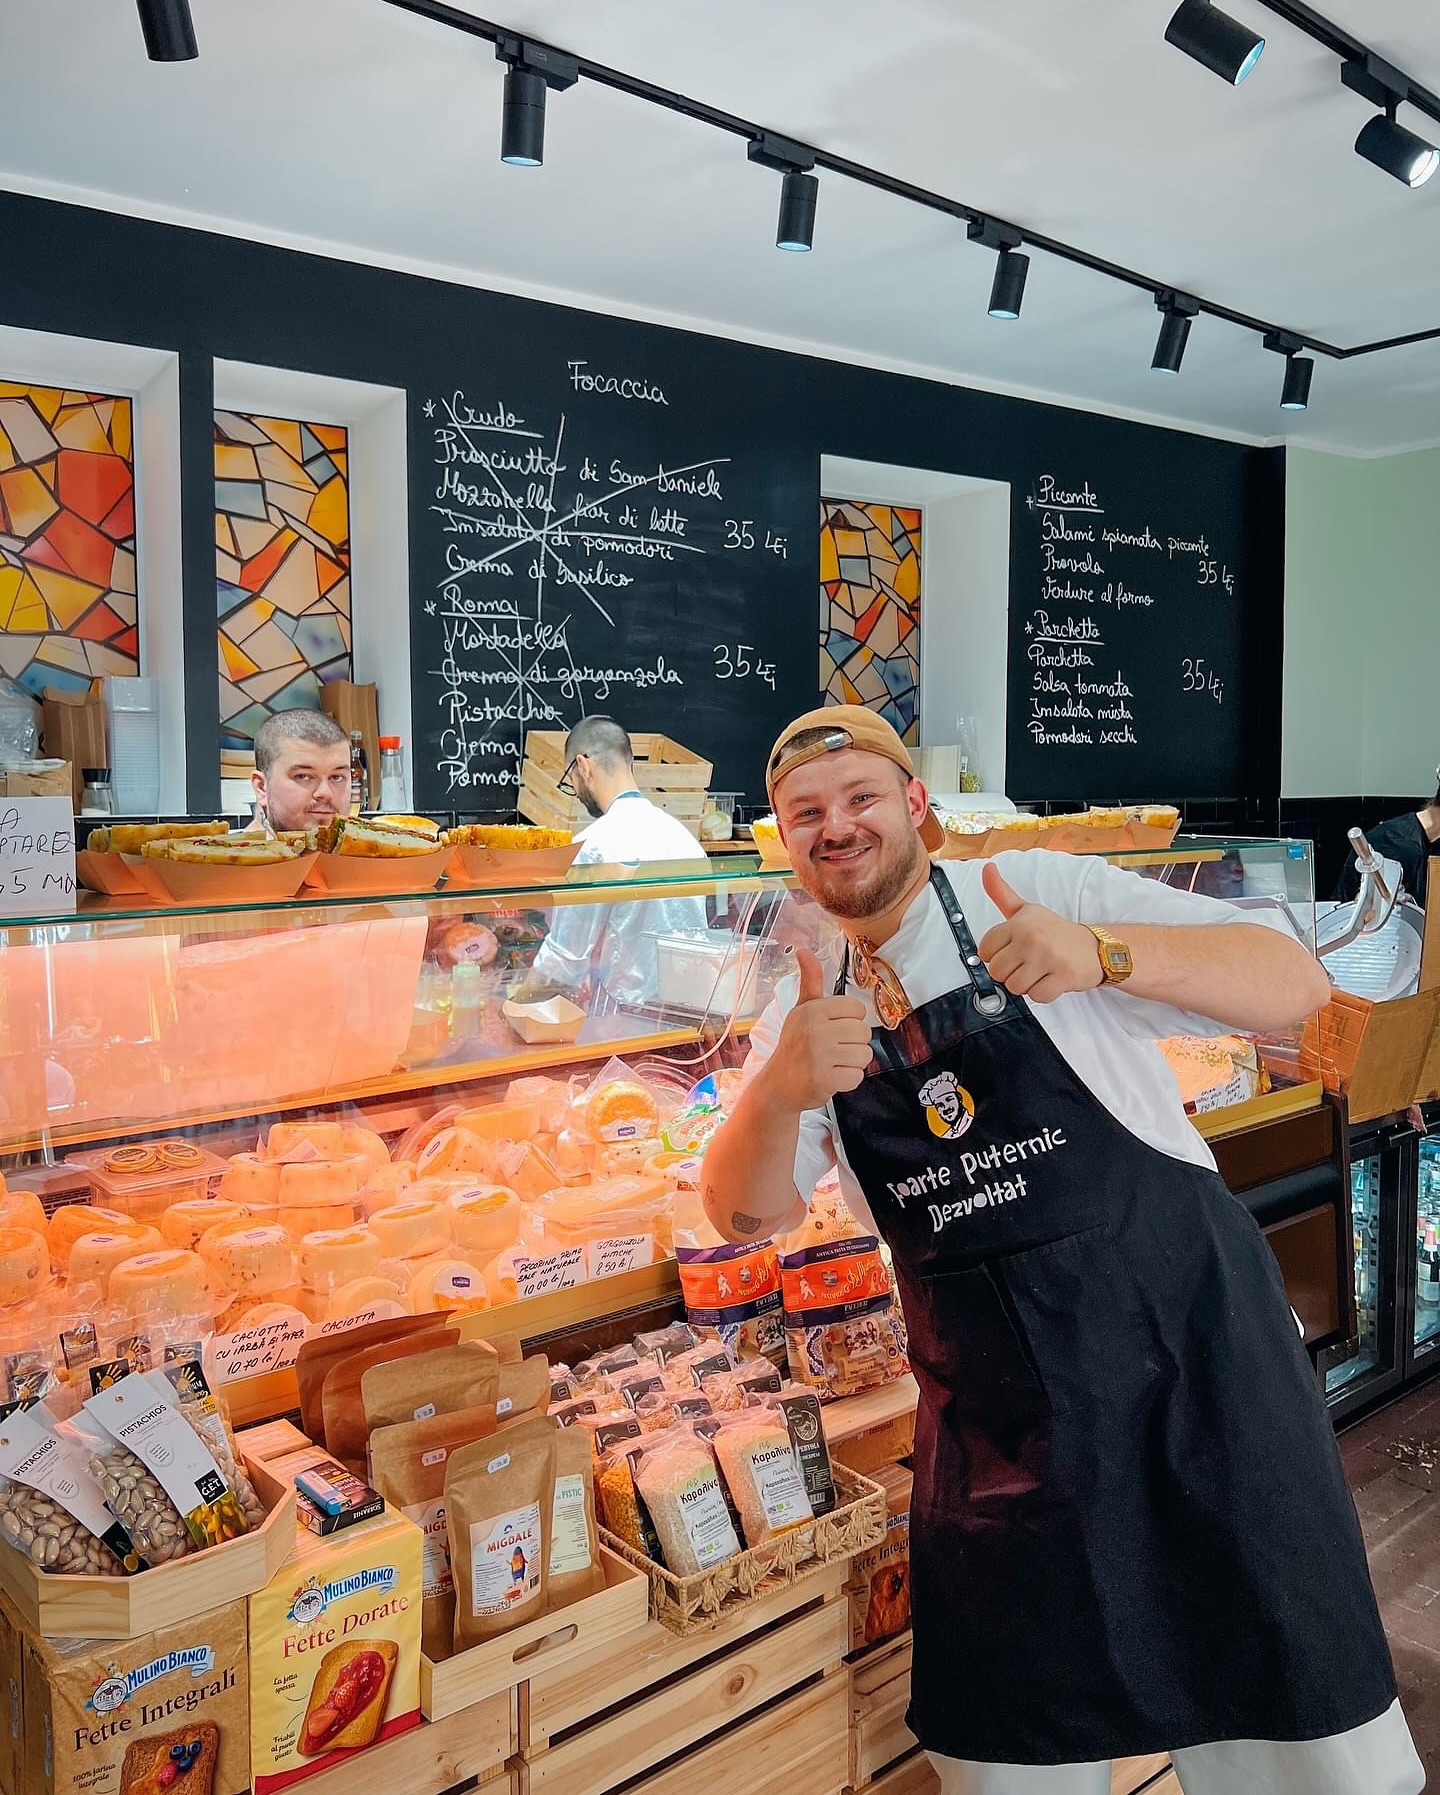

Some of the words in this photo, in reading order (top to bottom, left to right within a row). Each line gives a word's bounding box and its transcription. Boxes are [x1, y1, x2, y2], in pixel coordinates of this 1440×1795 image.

[568, 361, 669, 405] Focaccia
[452, 390, 526, 427] Crudo
[579, 458, 600, 481] di
[1037, 474, 1099, 507] Piccante
[618, 504, 639, 528] di
[649, 506, 689, 537] latte
[723, 519, 755, 550] 35
[1041, 511, 1096, 542] Salami
[550, 526, 571, 548] di
[580, 535, 674, 561] pomodori
[1040, 543, 1105, 575] Provola
[445, 544, 514, 576] Crema
[528, 559, 548, 579] di
[1196, 560, 1218, 585] 35
[443, 583, 519, 614] Roma
[1100, 583, 1112, 603] al
[442, 659, 522, 686] Crema
[530, 661, 550, 684] di
[712, 644, 755, 679] 35
[1181, 658, 1206, 691] 35
[1032, 669, 1072, 696] Salsa
[438, 691, 564, 725] Pistacchio
[1097, 699, 1134, 721] mista
[440, 729, 521, 760] Crema
[1026, 721, 1093, 745] Pomodori
[1100, 723, 1138, 745] secchi
[927, 1173, 1028, 1233] Dezvoltat
[231, 1321, 289, 1344] CACIOTTA
[320, 1311, 376, 1333] CACIOTTA
[215, 1349, 231, 1361] CU
[118, 1404, 168, 1438] PISTACHIOS
[13, 1438, 57, 1477] PISTACHIOS
[487, 1528, 533, 1554] MIGDALE
[322, 1577, 361, 1604] MULINO
[360, 1567, 395, 1589] BIANCO
[282, 1629, 337, 1659] Fette
[342, 1595, 410, 1636] Dorate
[127, 1659, 168, 1692] MULINO
[168, 1647, 208, 1670] BIANCO
[73, 1718, 132, 1752] Fette
[140, 1667, 238, 1727] Integrali
